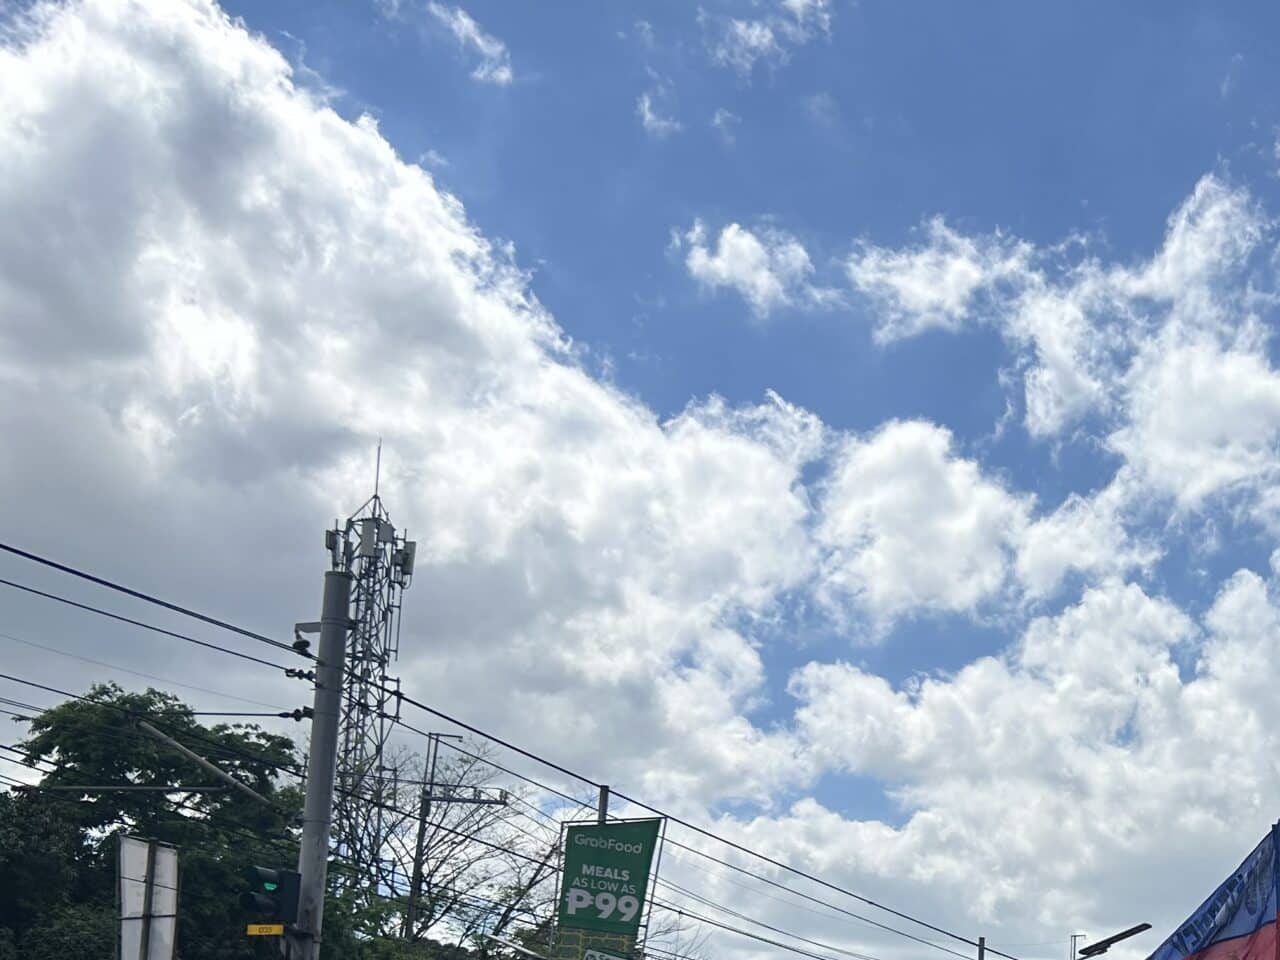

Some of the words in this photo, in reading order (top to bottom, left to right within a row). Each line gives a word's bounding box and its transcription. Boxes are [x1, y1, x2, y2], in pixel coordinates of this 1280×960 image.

[574, 833, 643, 854] GrabFood
[581, 863, 630, 881] MEALS
[571, 877, 589, 889] AS
[590, 879, 618, 892] LOW
[620, 882, 637, 895] AS
